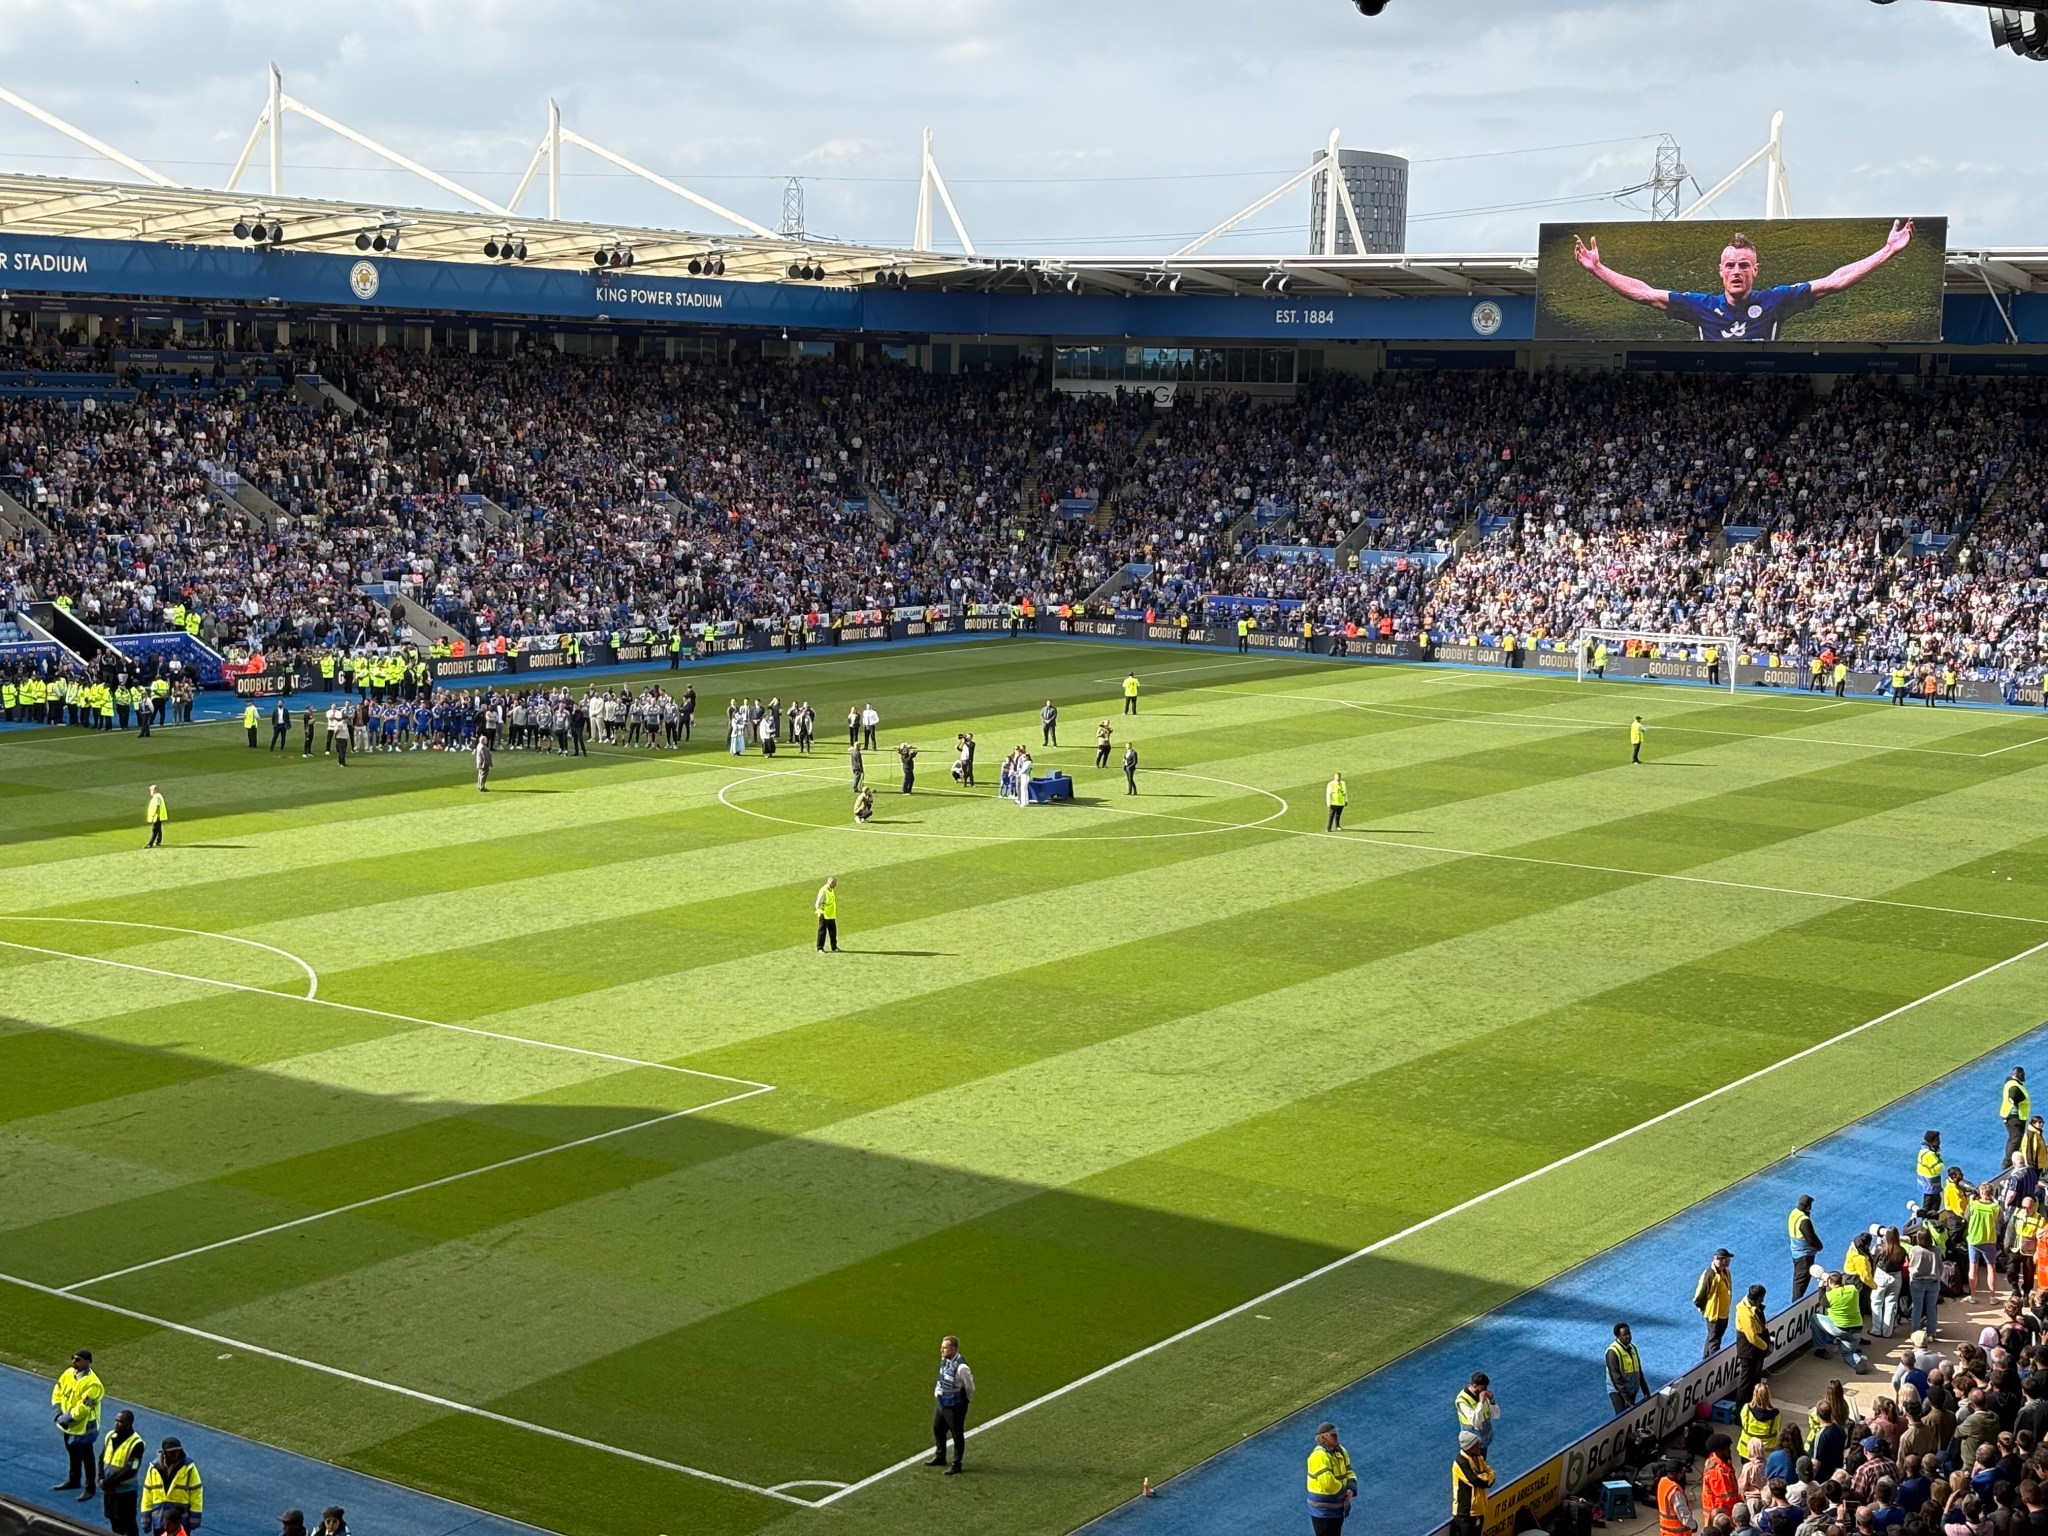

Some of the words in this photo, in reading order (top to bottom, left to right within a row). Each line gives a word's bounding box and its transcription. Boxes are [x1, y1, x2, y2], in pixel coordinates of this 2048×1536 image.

[14, 253, 88, 273] STADIUM
[596, 287, 628, 303] KING
[631, 289, 673, 306] POWER
[675, 292, 723, 308] STADIUM
[1275, 310, 1299, 324] EST.
[1303, 310, 1334, 324] 1884
[429, 620, 438, 628] V4
[907, 622, 926, 636] GOODB
[934, 620, 949, 633] GOAT
[964, 618, 999, 630] GOODBYE
[1002, 618, 1025, 629] GOT
[1060, 620, 1095, 633] GDBYE
[1097, 622, 1117, 635] GOAT
[770, 634, 799, 647] GOOYE
[841, 628, 868, 641] GOODBYE
[869, 626, 885, 638] GOAT
[1148, 626, 1182, 640] GOODBYE
[728, 637, 745, 651] GOAT
[1278, 636, 1299, 648] GOAT
[1375, 643, 1398, 656] GOAT
[651, 644, 668, 657] GOAT
[1434, 647, 1474, 661] GOODBYE
[1477, 649, 1500, 663] GOAT
[529, 652, 564, 668] GOODBYE
[566, 650, 585, 665] GAT
[437, 660, 474, 676] GOODBYE
[477, 658, 497, 673] GOAT
[1649, 662, 1692, 677] GOODBYE
[1764, 670, 1796, 684] GOODB
[1682, 1354, 1741, 1414] BC.GAME
[1494, 1502, 1501, 1518] IT
[1501, 1498, 1508, 1513] IS
[1507, 1494, 1517, 1510] AN
[1516, 1472, 1550, 1504] ARRESTABLE
[1541, 1485, 1559, 1507] POINT
